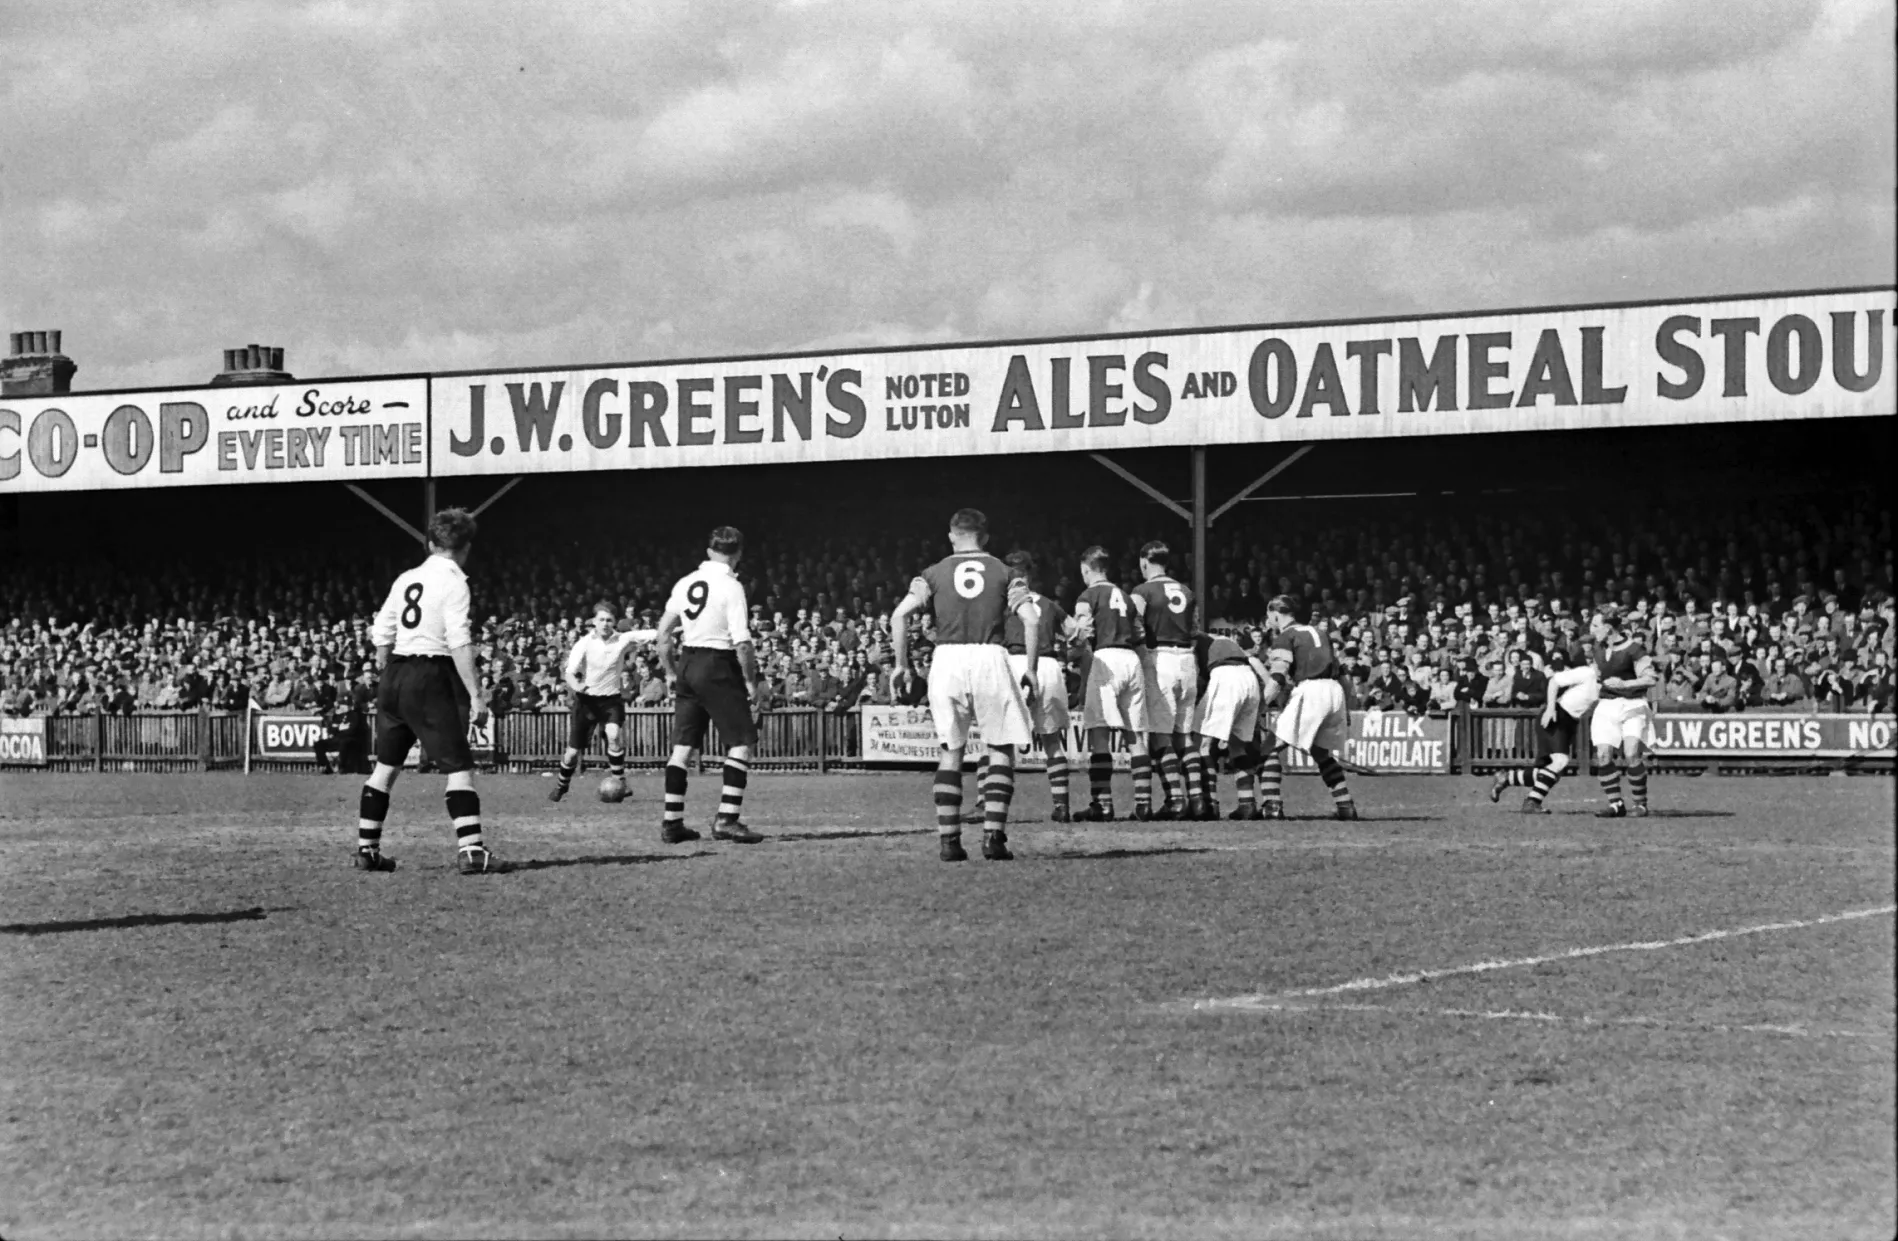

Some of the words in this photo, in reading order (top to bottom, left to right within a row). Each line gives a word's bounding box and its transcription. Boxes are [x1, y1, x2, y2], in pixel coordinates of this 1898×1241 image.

[886, 372, 970, 400] NOTED
[991, 351, 1172, 432] ALES
[1181, 371, 1238, 400] AND
[1248, 326, 1628, 420] OATMEAL
[1656, 309, 1898, 401] STOU
[227, 394, 280, 421] and
[296, 390, 372, 417] Score
[450, 364, 866, 457] J.W.GREEN'S
[886, 403, 970, 432] LUTON
[218, 427, 332, 471] EVERY
[339, 422, 422, 466] TIME
[953, 560, 986, 599] 6
[401, 582, 424, 629] 8
[683, 580, 709, 621] 9
[1109, 587, 1127, 617] 4
[1163, 583, 1187, 614] 5
[1295, 625, 1322, 648] 7
[1362, 714, 1424, 737] MILK
[1344, 738, 1443, 767] CHOCOLATE
